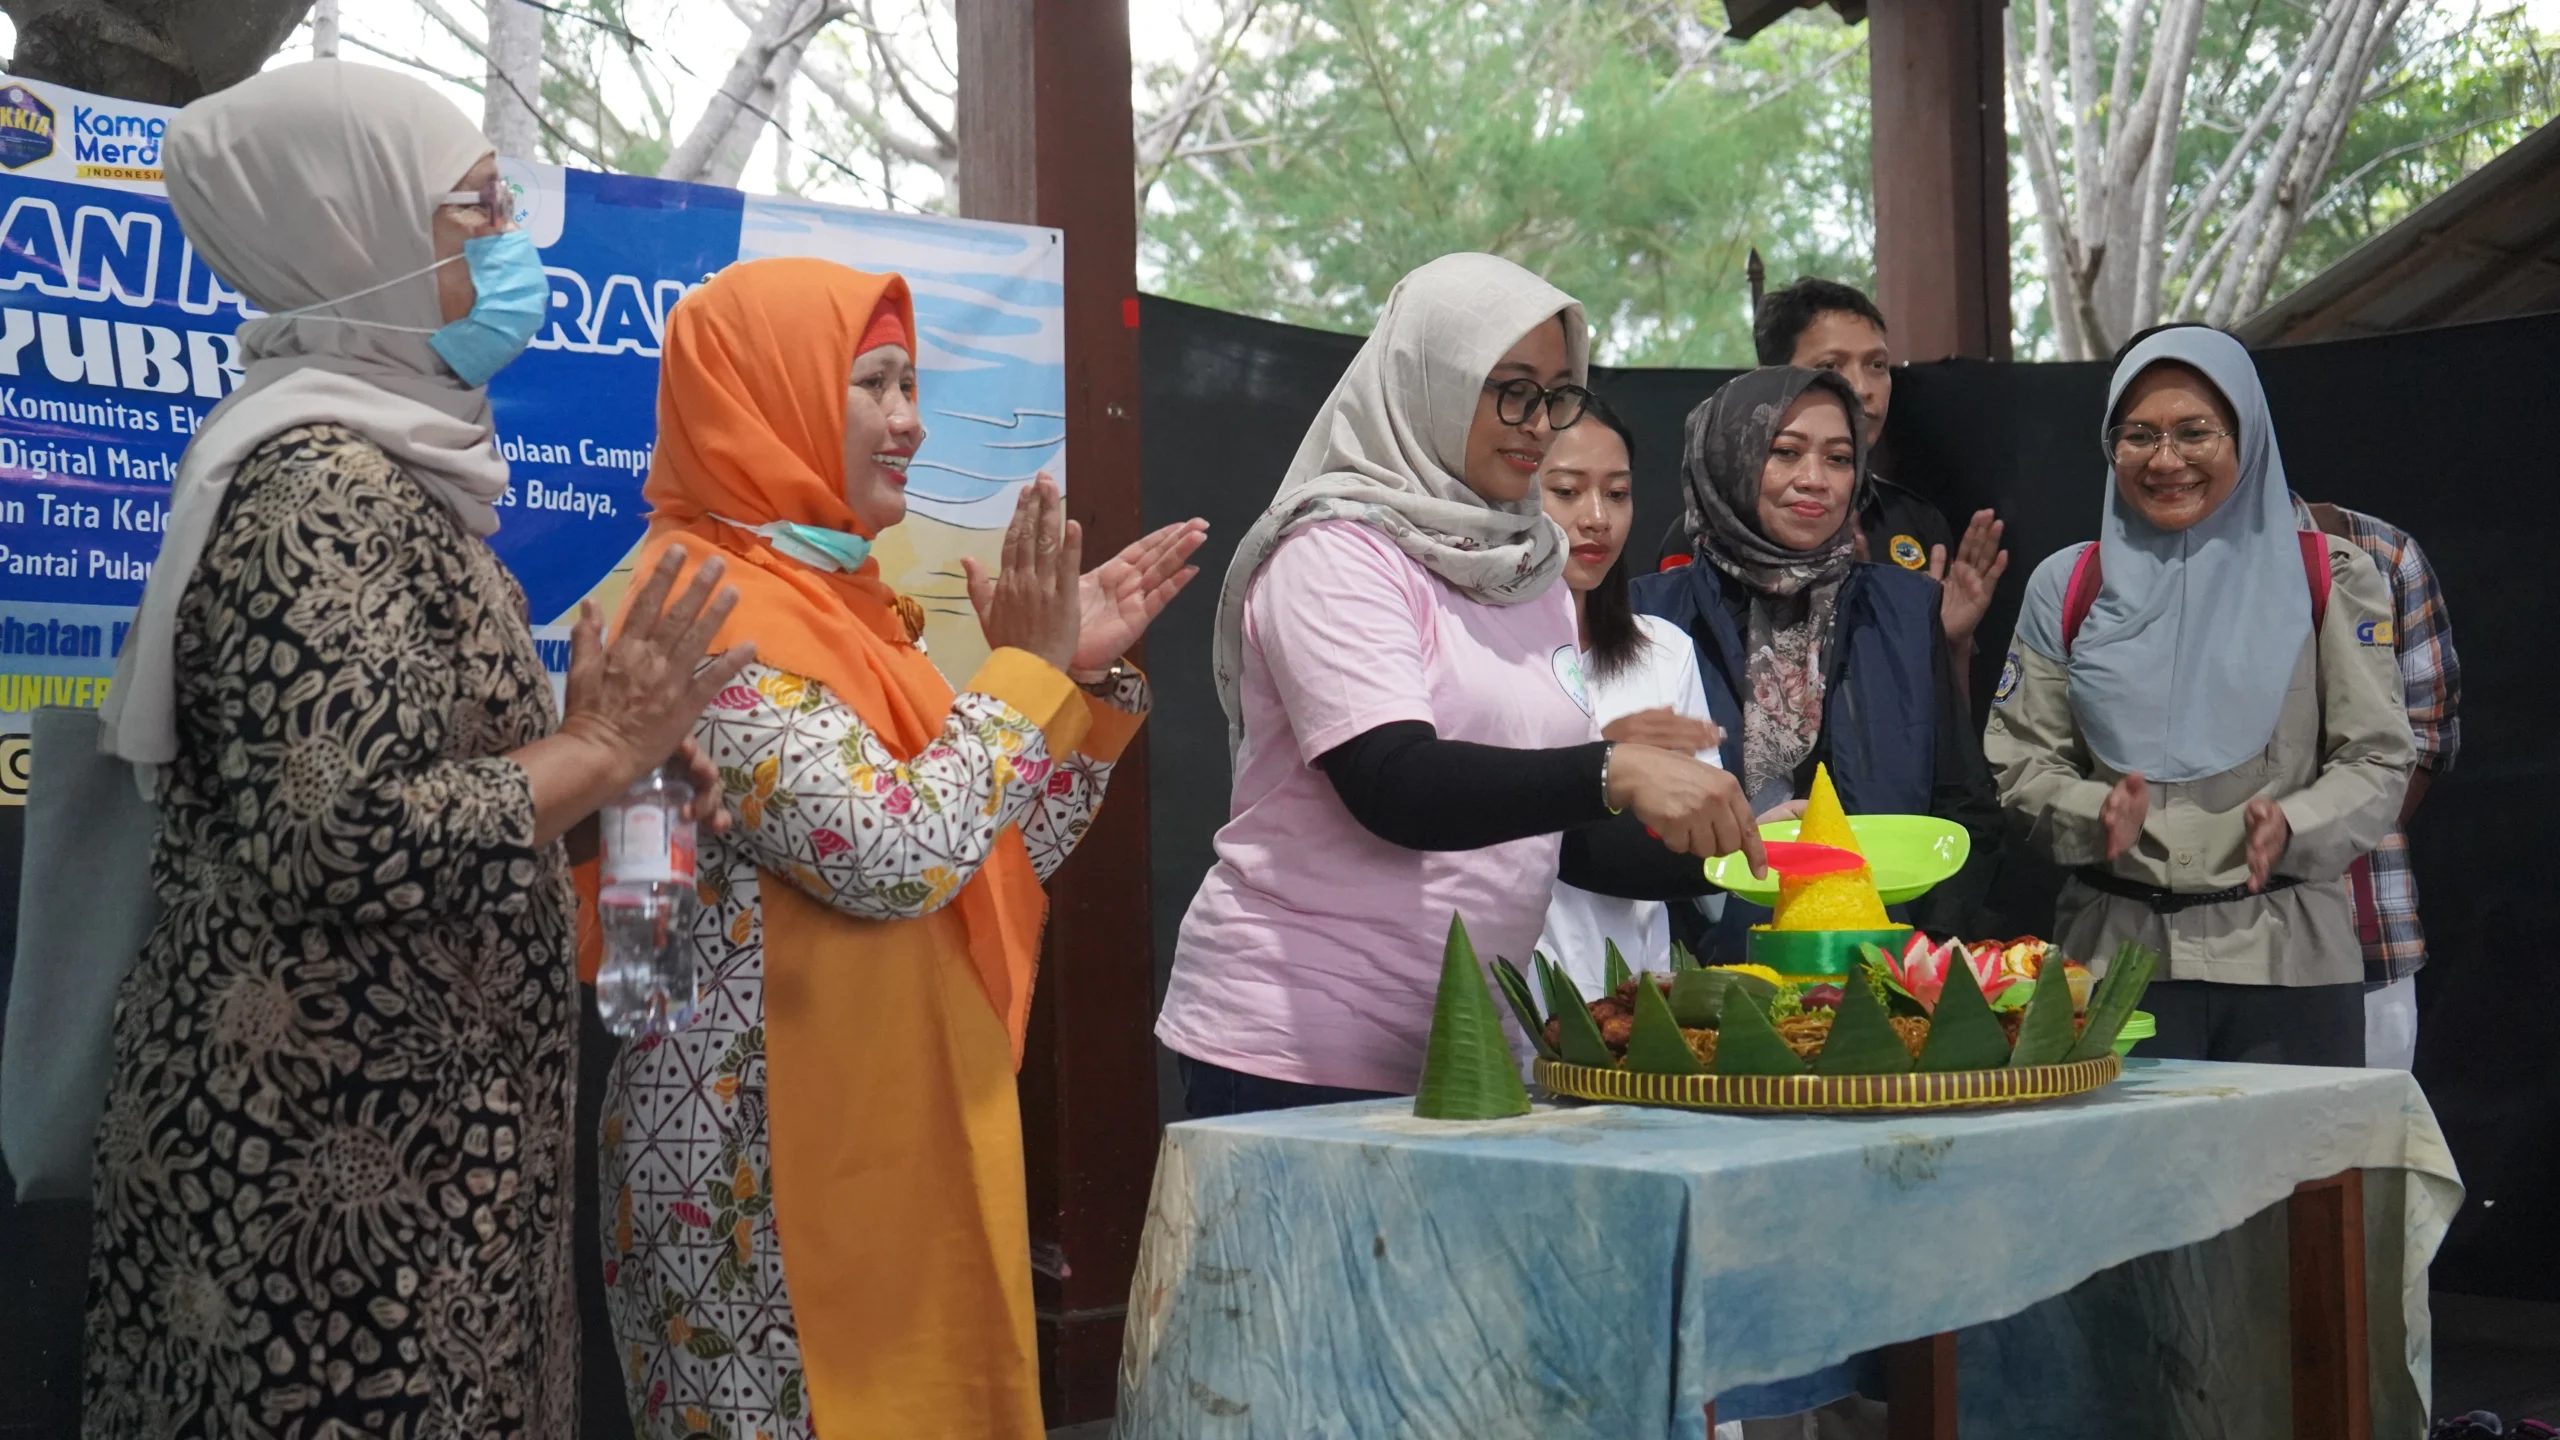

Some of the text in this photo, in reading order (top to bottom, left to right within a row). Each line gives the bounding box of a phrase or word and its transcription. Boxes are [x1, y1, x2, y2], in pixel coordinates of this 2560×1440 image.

[73, 105, 169, 145] Kamp
[0, 387, 160, 431] Komunitas
[0, 438, 97, 480] Digital
[37, 493, 100, 529] Tata
[527, 479, 617, 520] Budaya,
[0, 616, 101, 657] hatan
